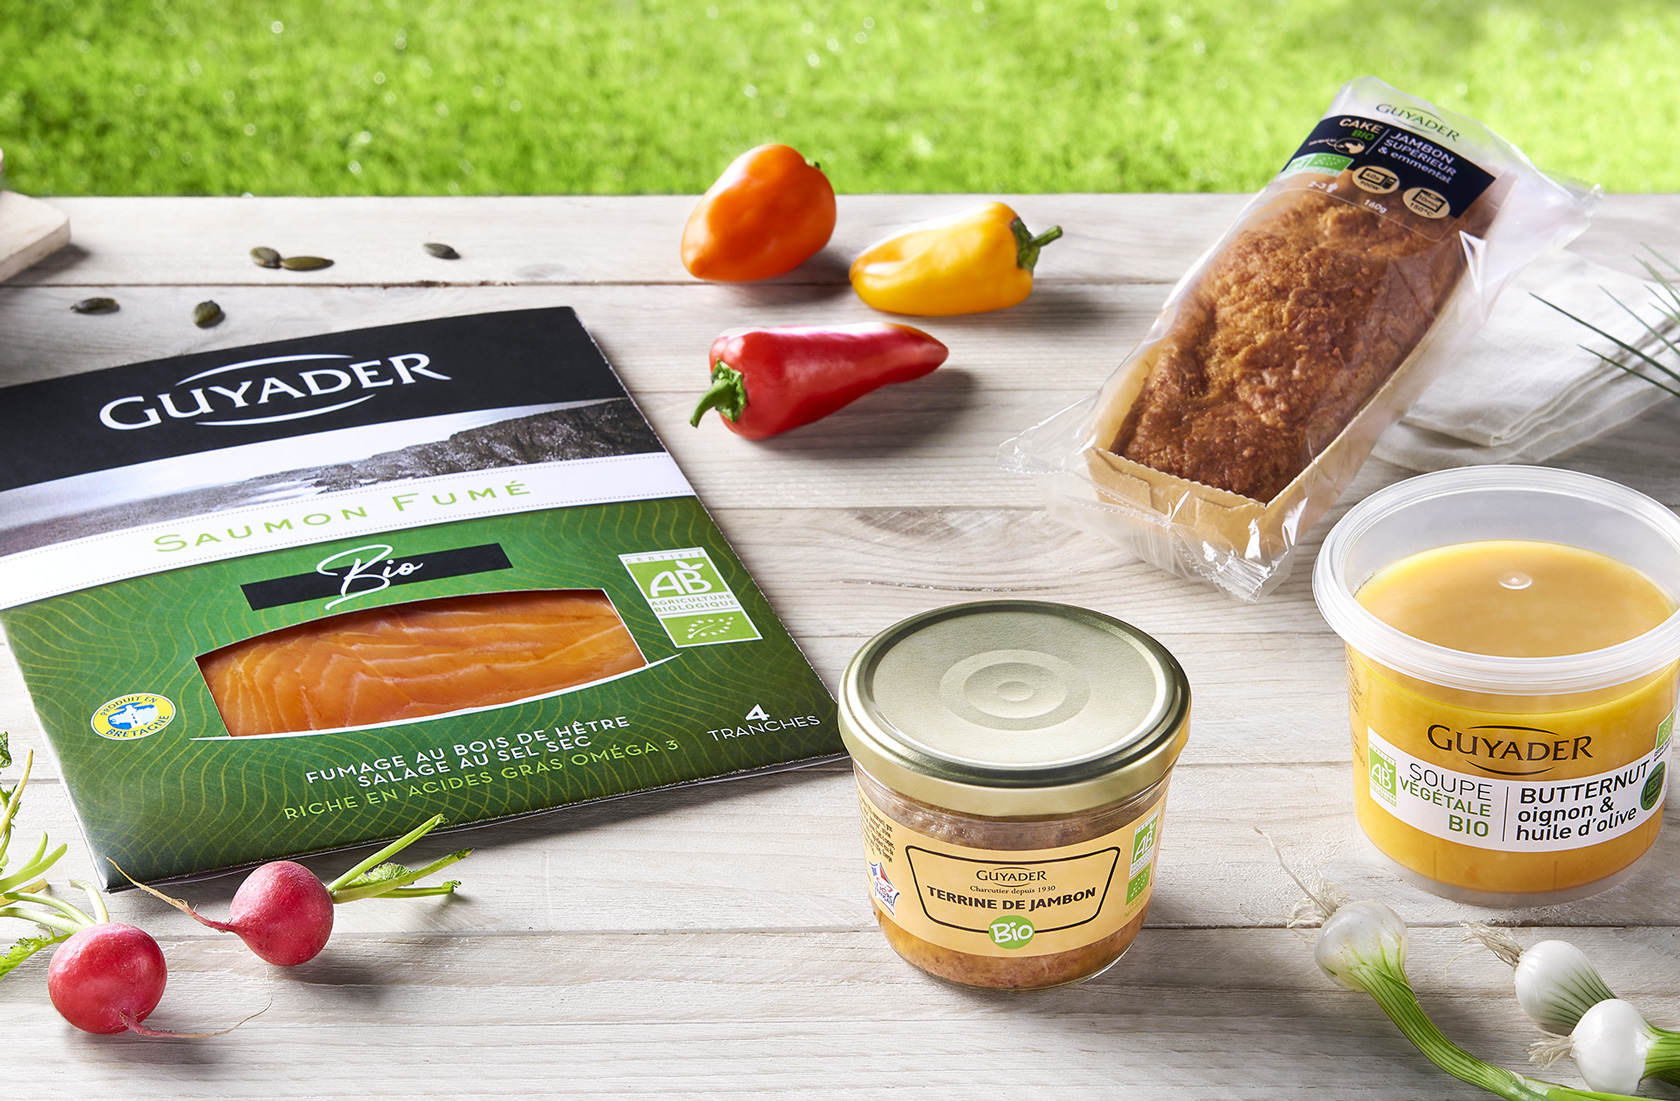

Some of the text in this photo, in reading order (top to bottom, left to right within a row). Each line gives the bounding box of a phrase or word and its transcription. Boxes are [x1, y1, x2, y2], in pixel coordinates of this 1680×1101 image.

[1339, 118, 1383, 134] CAKE
[1351, 129, 1375, 141] BIO
[1375, 103, 1460, 142] GUYADER
[1383, 138, 1457, 176] SUPÉRIEUR
[1389, 132, 1455, 165] JAMBON
[1377, 145, 1453, 184] & emmental
[1364, 199, 1387, 214] 160g
[99, 353, 452, 430] GUYADER
[153, 480, 531, 553] SAUMON FUMÉ
[316, 544, 424, 611] Bio
[650, 569, 712, 597] AB
[651, 594, 733, 606] AGRICULTURE
[654, 601, 738, 613] BIOLOGIQUE
[100, 696, 141, 716] PRODUIT
[745, 703, 770, 721] 4
[106, 715, 169, 738] BRETAGNE
[707, 715, 821, 741] TRANCHES
[305, 716, 630, 784] FUMAGE AU BOIS DE HÊTRE
[1427, 724, 1594, 761] GUYADER
[357, 735, 591, 787] SALAGE AU SEL SEC
[284, 739, 678, 819] RICHE EN ACIDES GRAS OMÉGA 3
[1371, 763, 1392, 790] AB
[1409, 763, 1493, 801] SOUPE
[1520, 759, 1650, 804] BUTTERNUT
[1400, 776, 1491, 818] VÉGÉTALE
[1517, 796, 1614, 826] oignon &
[1449, 814, 1489, 837] BIO
[1516, 807, 1637, 841] huile d'olive
[970, 885, 1056, 896] Charcutier depuis 1930
[976, 870, 1047, 882] GUYADER
[927, 886, 998, 910] TERRINE
[1002, 900, 1026, 910] DE
[1029, 887, 1097, 912] JAMBON
[990, 922, 1034, 944] Bio
